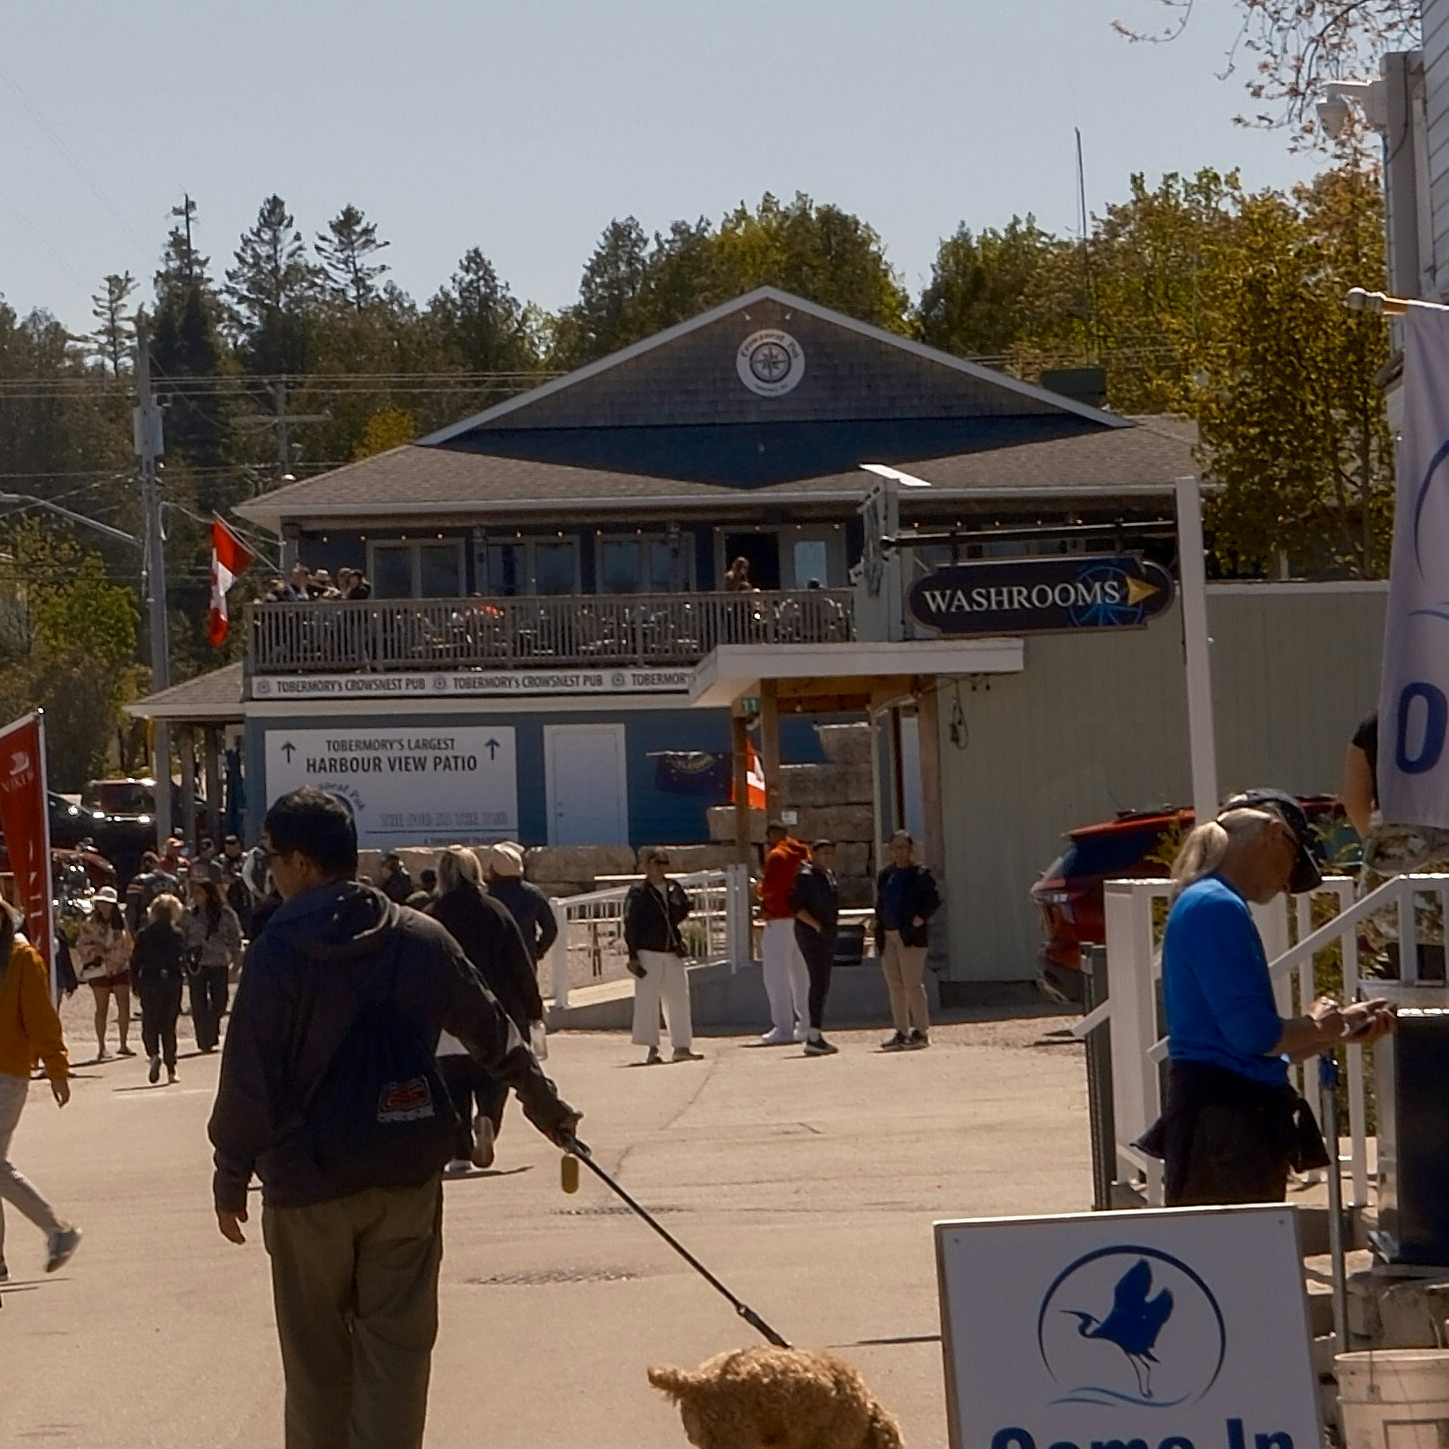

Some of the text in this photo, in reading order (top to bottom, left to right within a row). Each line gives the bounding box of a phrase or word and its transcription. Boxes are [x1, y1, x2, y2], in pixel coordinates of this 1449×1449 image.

[922, 580, 1121, 614] WASHROOMS
[345, 678, 402, 691] CROWSNEST
[405, 677, 426, 690] PUB
[522, 674, 581, 688] CROWSNEST
[583, 673, 603, 687] PUB
[326, 738, 456, 752] TOBERMORY'S LARGEST
[306, 755, 478, 774] HARBOUR VIEW PATIO
